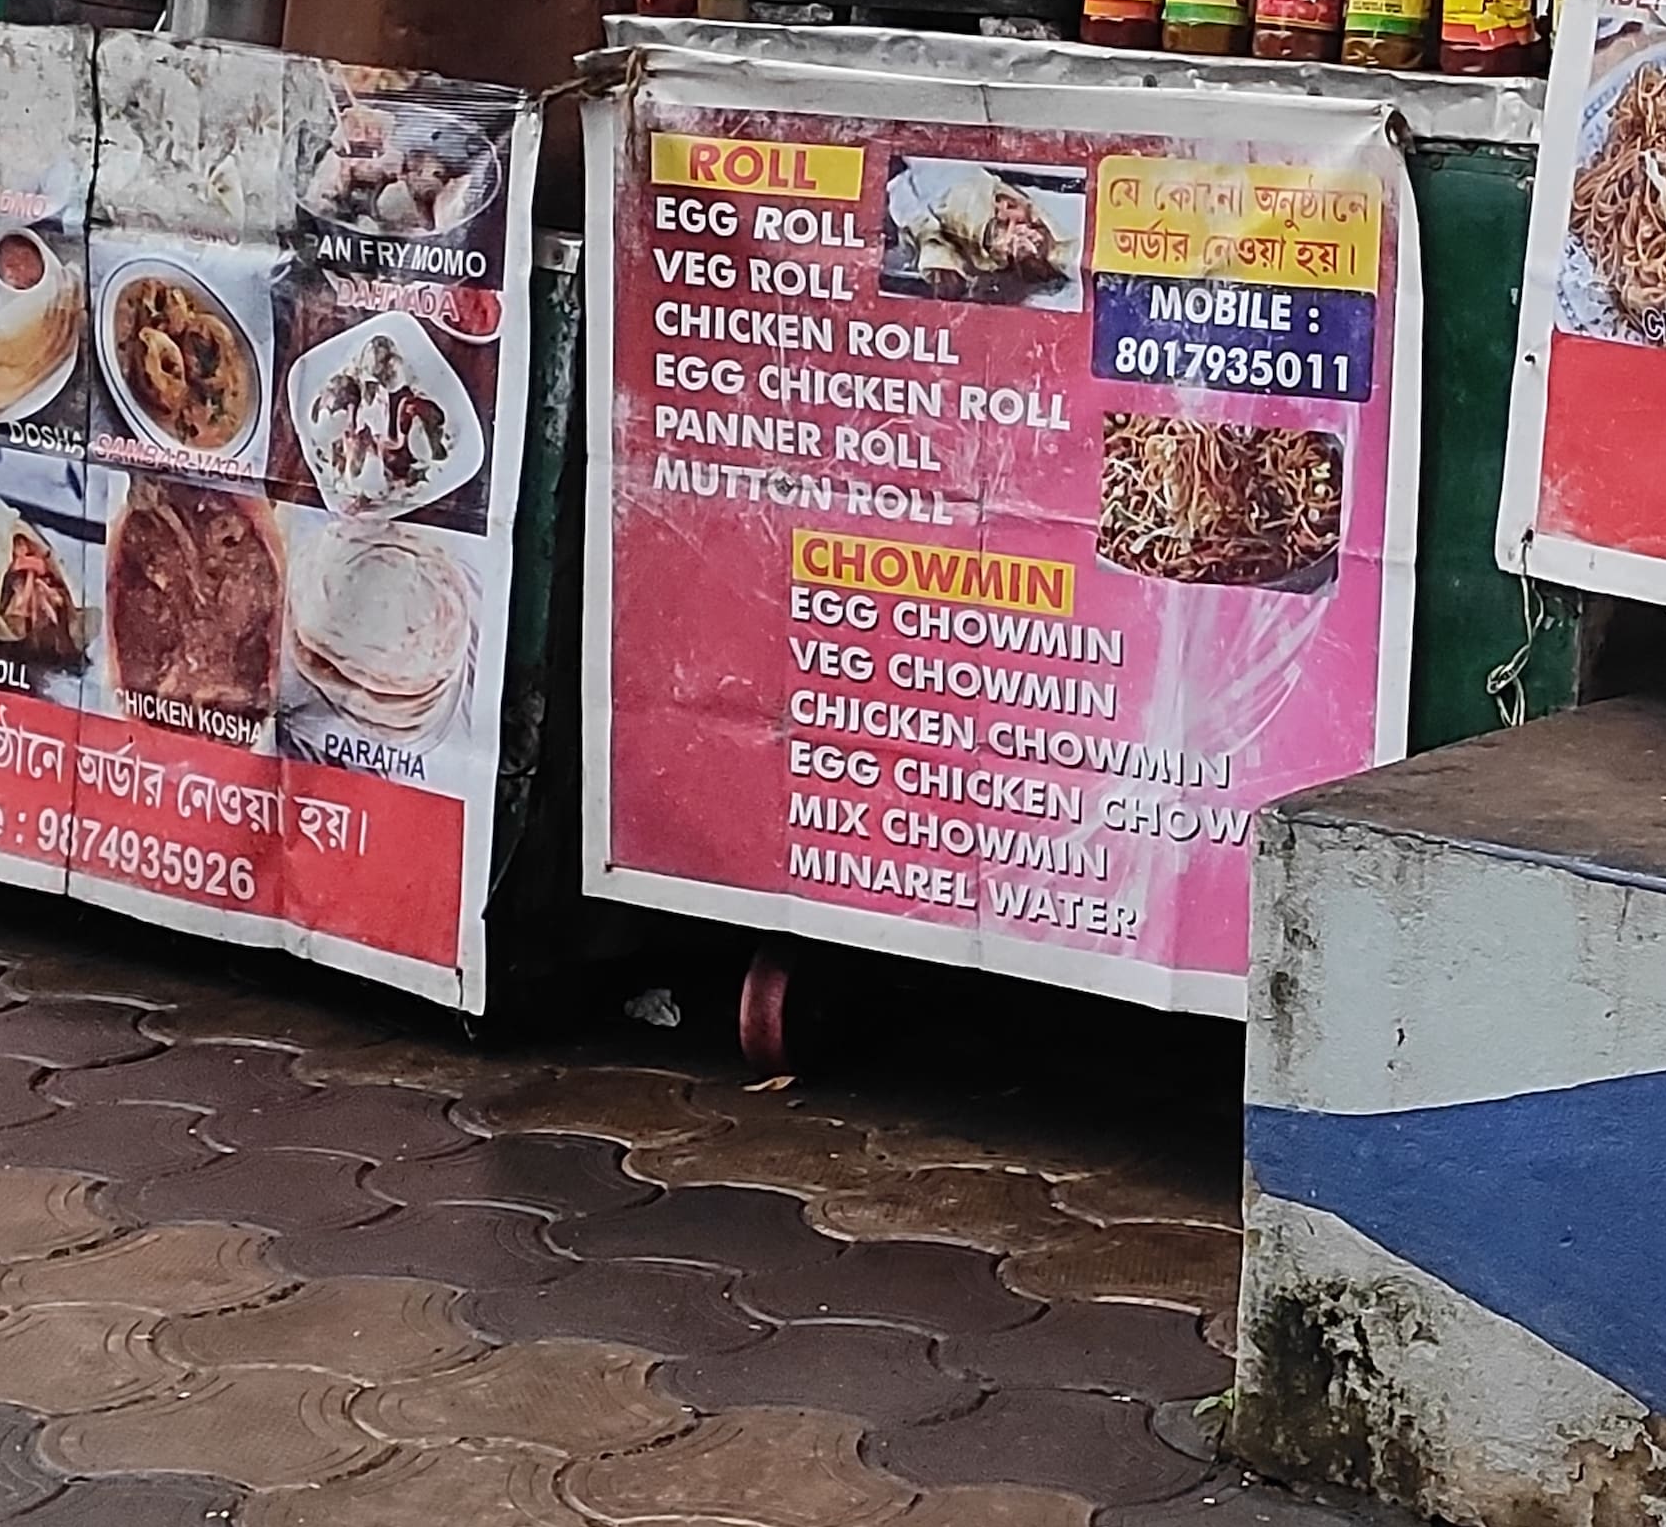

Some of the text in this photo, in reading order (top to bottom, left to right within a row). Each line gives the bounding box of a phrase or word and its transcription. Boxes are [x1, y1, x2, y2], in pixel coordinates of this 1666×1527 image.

[688, 142, 818, 192] ROLL
[654, 196, 865, 249] EGG ROLL
[1109, 176, 1140, 211] যে
[1253, 173, 1370, 233] অনুষ্ঠানে
[360, 240, 487, 278] FRY MOMO
[1112, 218, 1190, 265] অর্ডার
[652, 248, 855, 302] VEG ROLL
[1149, 284, 1293, 332] MOBILE
[654, 301, 960, 366] CHICKEN ROLL
[1114, 337, 1351, 392] 8017935011
[654, 353, 1071, 431] EGG CHICKEN ROLL
[8, 420, 86, 453] DOSHA
[654, 404, 942, 472] PANNER ROLL
[652, 457, 955, 526] MUTTON ROLL
[800, 537, 1066, 610] CHOWMIN
[789, 585, 1124, 667] EGG CHOWMIN
[788, 636, 1118, 720] VEG CHOWMIN
[198, 708, 263, 746] KOSHA
[324, 733, 426, 781] PARATHA
[790, 688, 1232, 790] CHICKEN CHOWMIN
[75, 740, 165, 809] অর্ডার
[177, 772, 287, 837] নেওয়া
[789, 741, 880, 787] EGG
[893, 756, 1084, 824] CHICKEN
[36, 806, 257, 901] 9874935926
[788, 791, 1110, 881] MIX CHOWMIN
[788, 843, 1139, 939] MINAREL WATER
